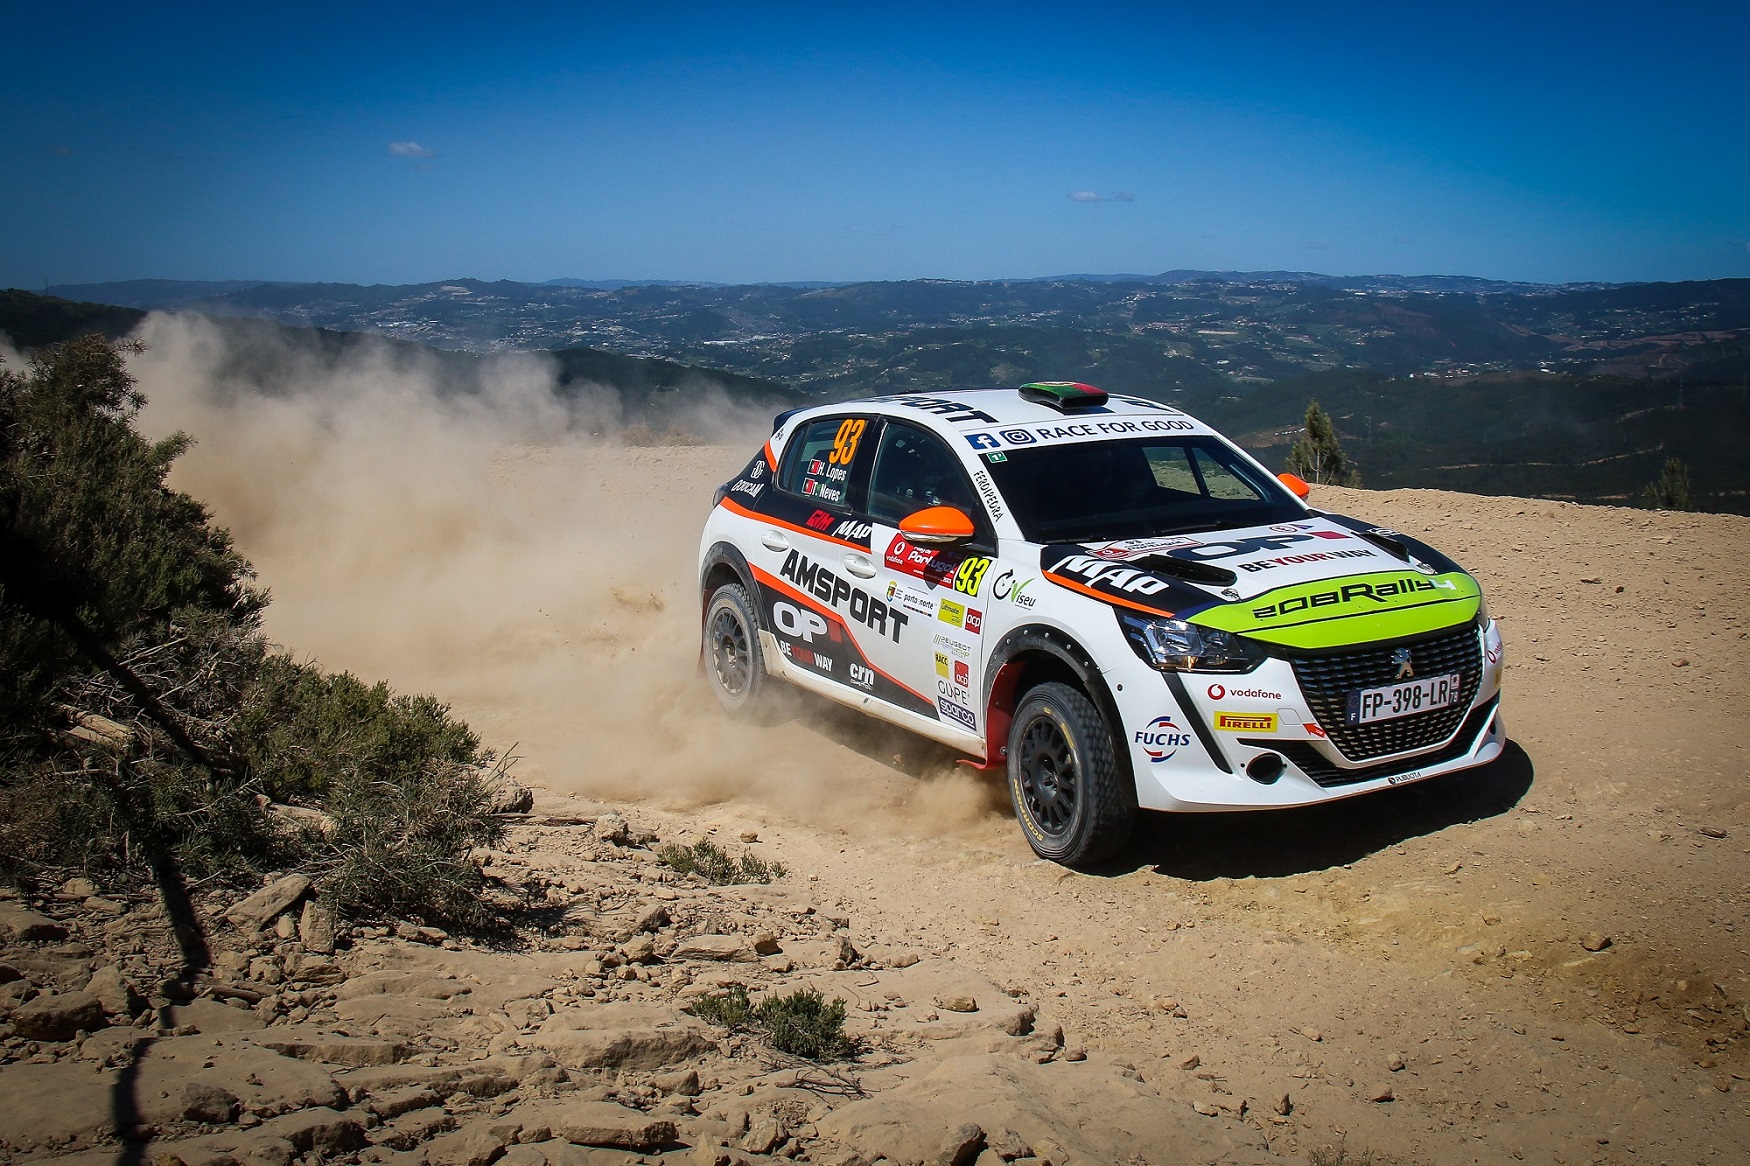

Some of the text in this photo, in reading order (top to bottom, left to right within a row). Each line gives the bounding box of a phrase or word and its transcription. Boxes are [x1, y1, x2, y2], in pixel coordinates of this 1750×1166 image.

[1035, 424, 1099, 440] RACE
[1096, 421, 1141, 434] FOR
[1141, 420, 1195, 431] GOOD
[828, 418, 866, 465] 93
[826, 463, 847, 482] Lopes
[820, 483, 841, 502] Neves
[973, 470, 1004, 523] FERDIPEDRA
[831, 520, 873, 541] MAP
[955, 557, 990, 596] 93
[1047, 555, 1170, 595] MAP
[779, 548, 909, 644] AMSPORT
[1230, 688, 1282, 700] vodafone
[1361, 680, 1449, 719] FP-398-LR
[940, 700, 974, 725] sparco
[1219, 715, 1273, 729] PIRELLI
[1350, 712, 1357, 721] F
[1134, 731, 1191, 747] FUCHS
